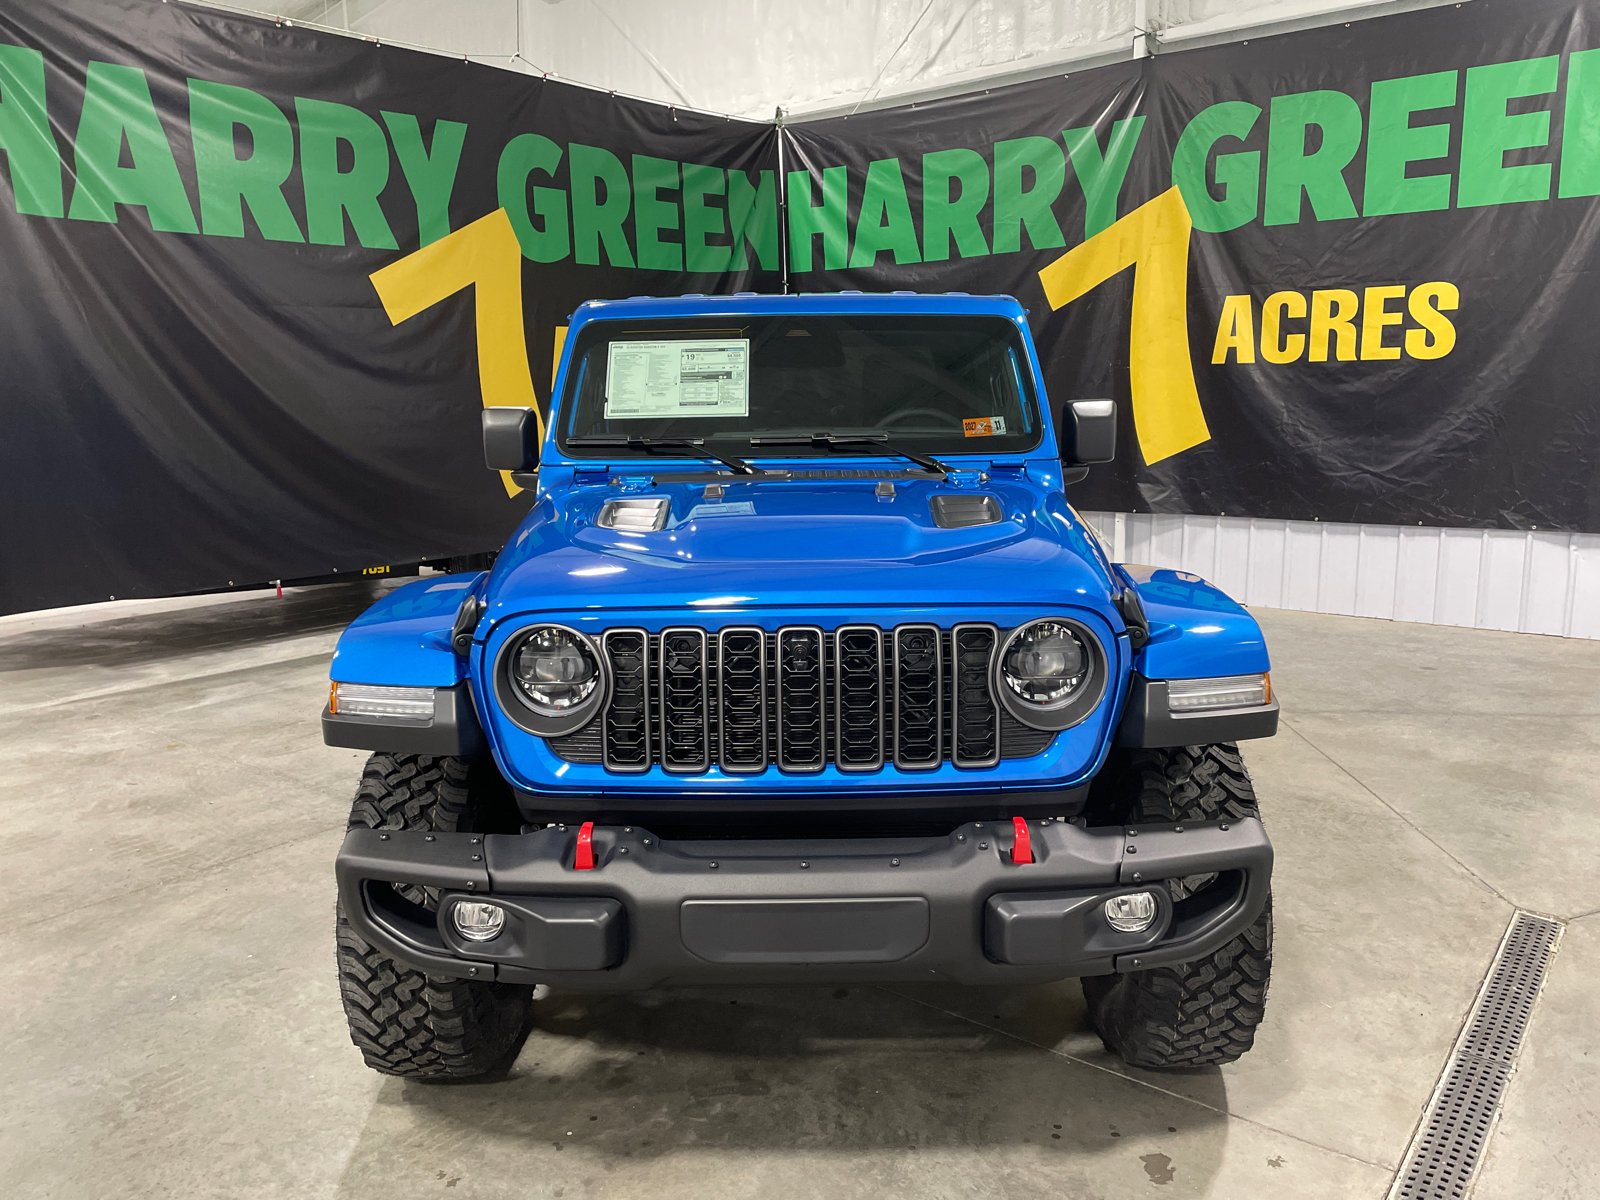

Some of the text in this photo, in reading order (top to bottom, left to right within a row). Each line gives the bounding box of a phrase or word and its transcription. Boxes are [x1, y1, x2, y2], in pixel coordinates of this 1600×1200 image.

[497, 132, 779, 273] GREEN
[787, 115, 1147, 273] HARRY
[369, 207, 543, 499] 7
[686, 353, 695, 361] 19
[1037, 184, 1459, 467] 7 ACRES
[964, 421, 977, 431] 2027
